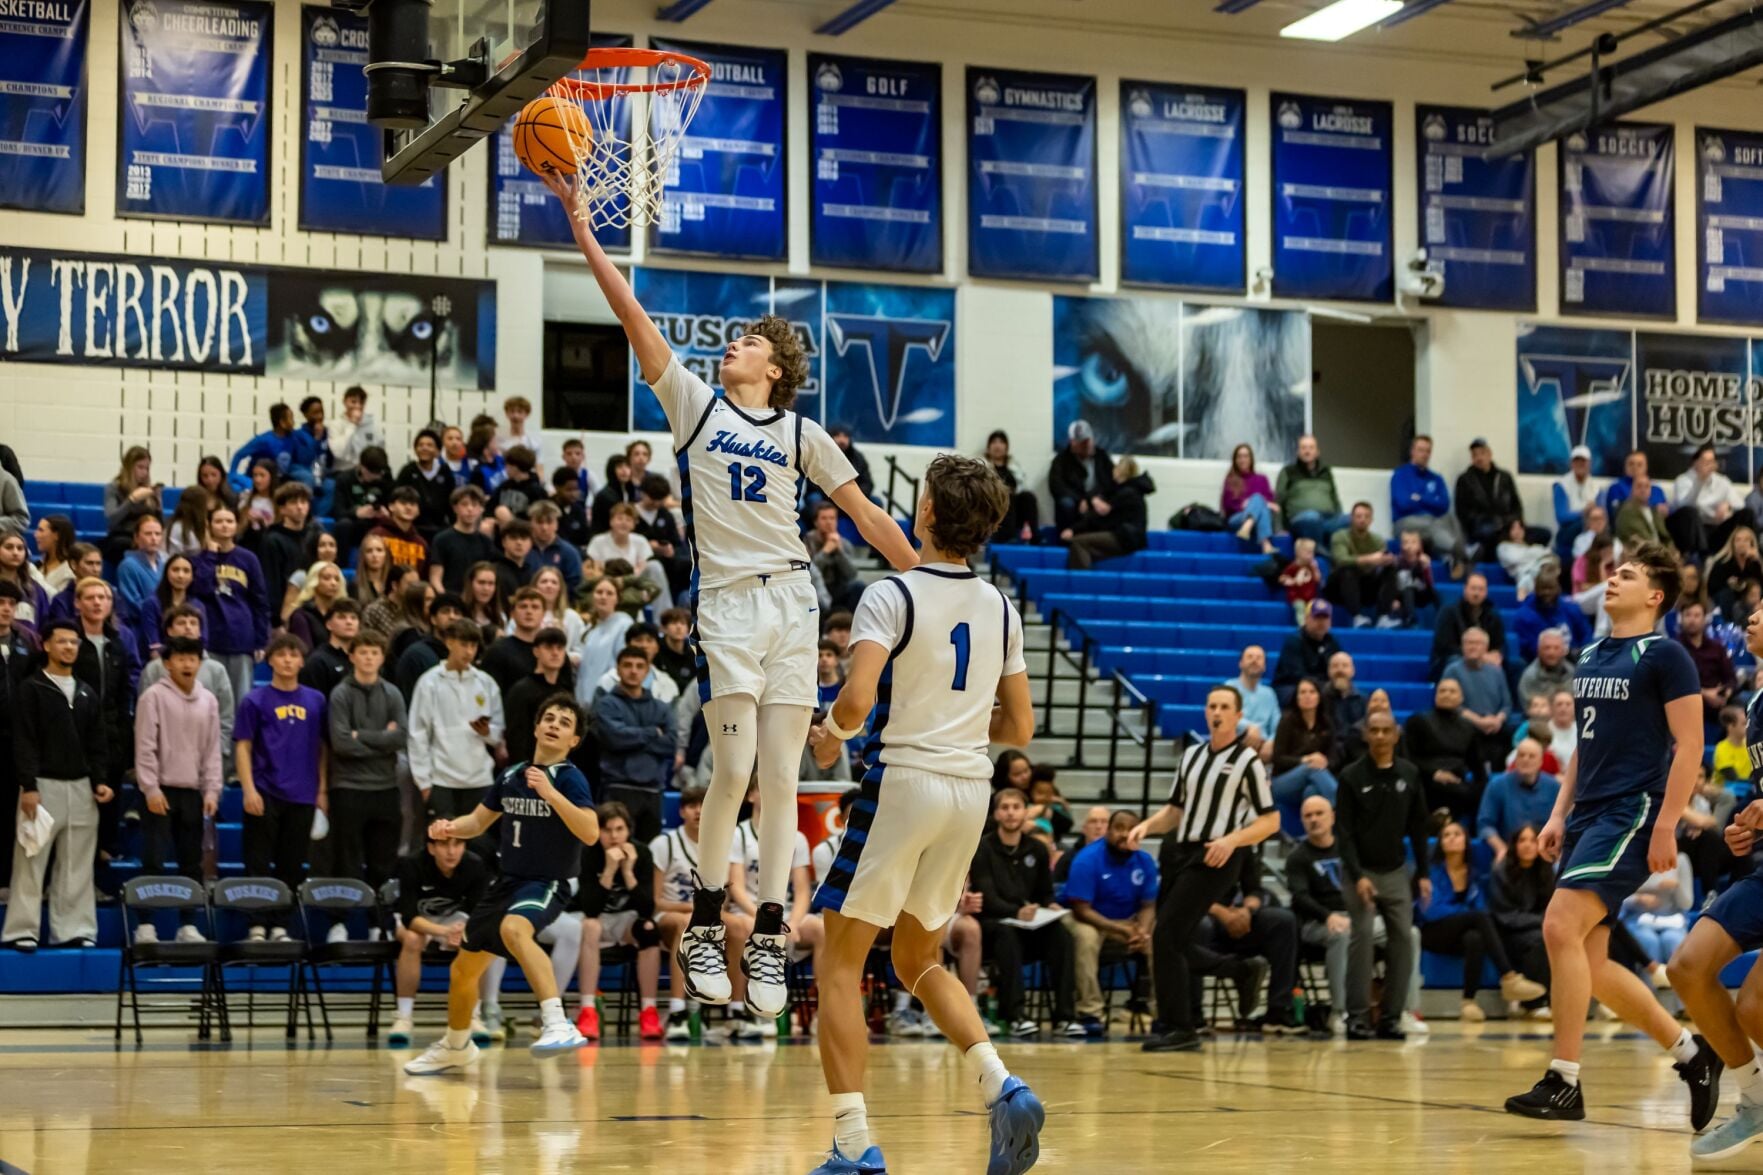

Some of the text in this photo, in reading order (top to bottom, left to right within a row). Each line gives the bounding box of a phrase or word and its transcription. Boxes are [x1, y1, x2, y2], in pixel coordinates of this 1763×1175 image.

[163, 13, 259, 38] CHEERLEADING
[710, 62, 765, 84] OTBALL
[6, 83, 58, 95] CHAMPIONS
[866, 76, 908, 96] GOLF
[147, 95, 244, 110] REGIONAL CHAMPIONS
[1004, 88, 1083, 110] GYMNASTICS
[1163, 101, 1226, 123] LACROSSE
[1312, 112, 1373, 134] LACROSSE
[0, 257, 254, 366] Y TERROR
[1647, 369, 1740, 401] HOME
[706, 430, 788, 468] Huskies
[727, 461, 768, 503] 12
[950, 622, 971, 691] 1
[1572, 676, 1630, 700] OLVERINES
[1581, 706, 1597, 740] 2
[512, 820, 522, 848] 1
